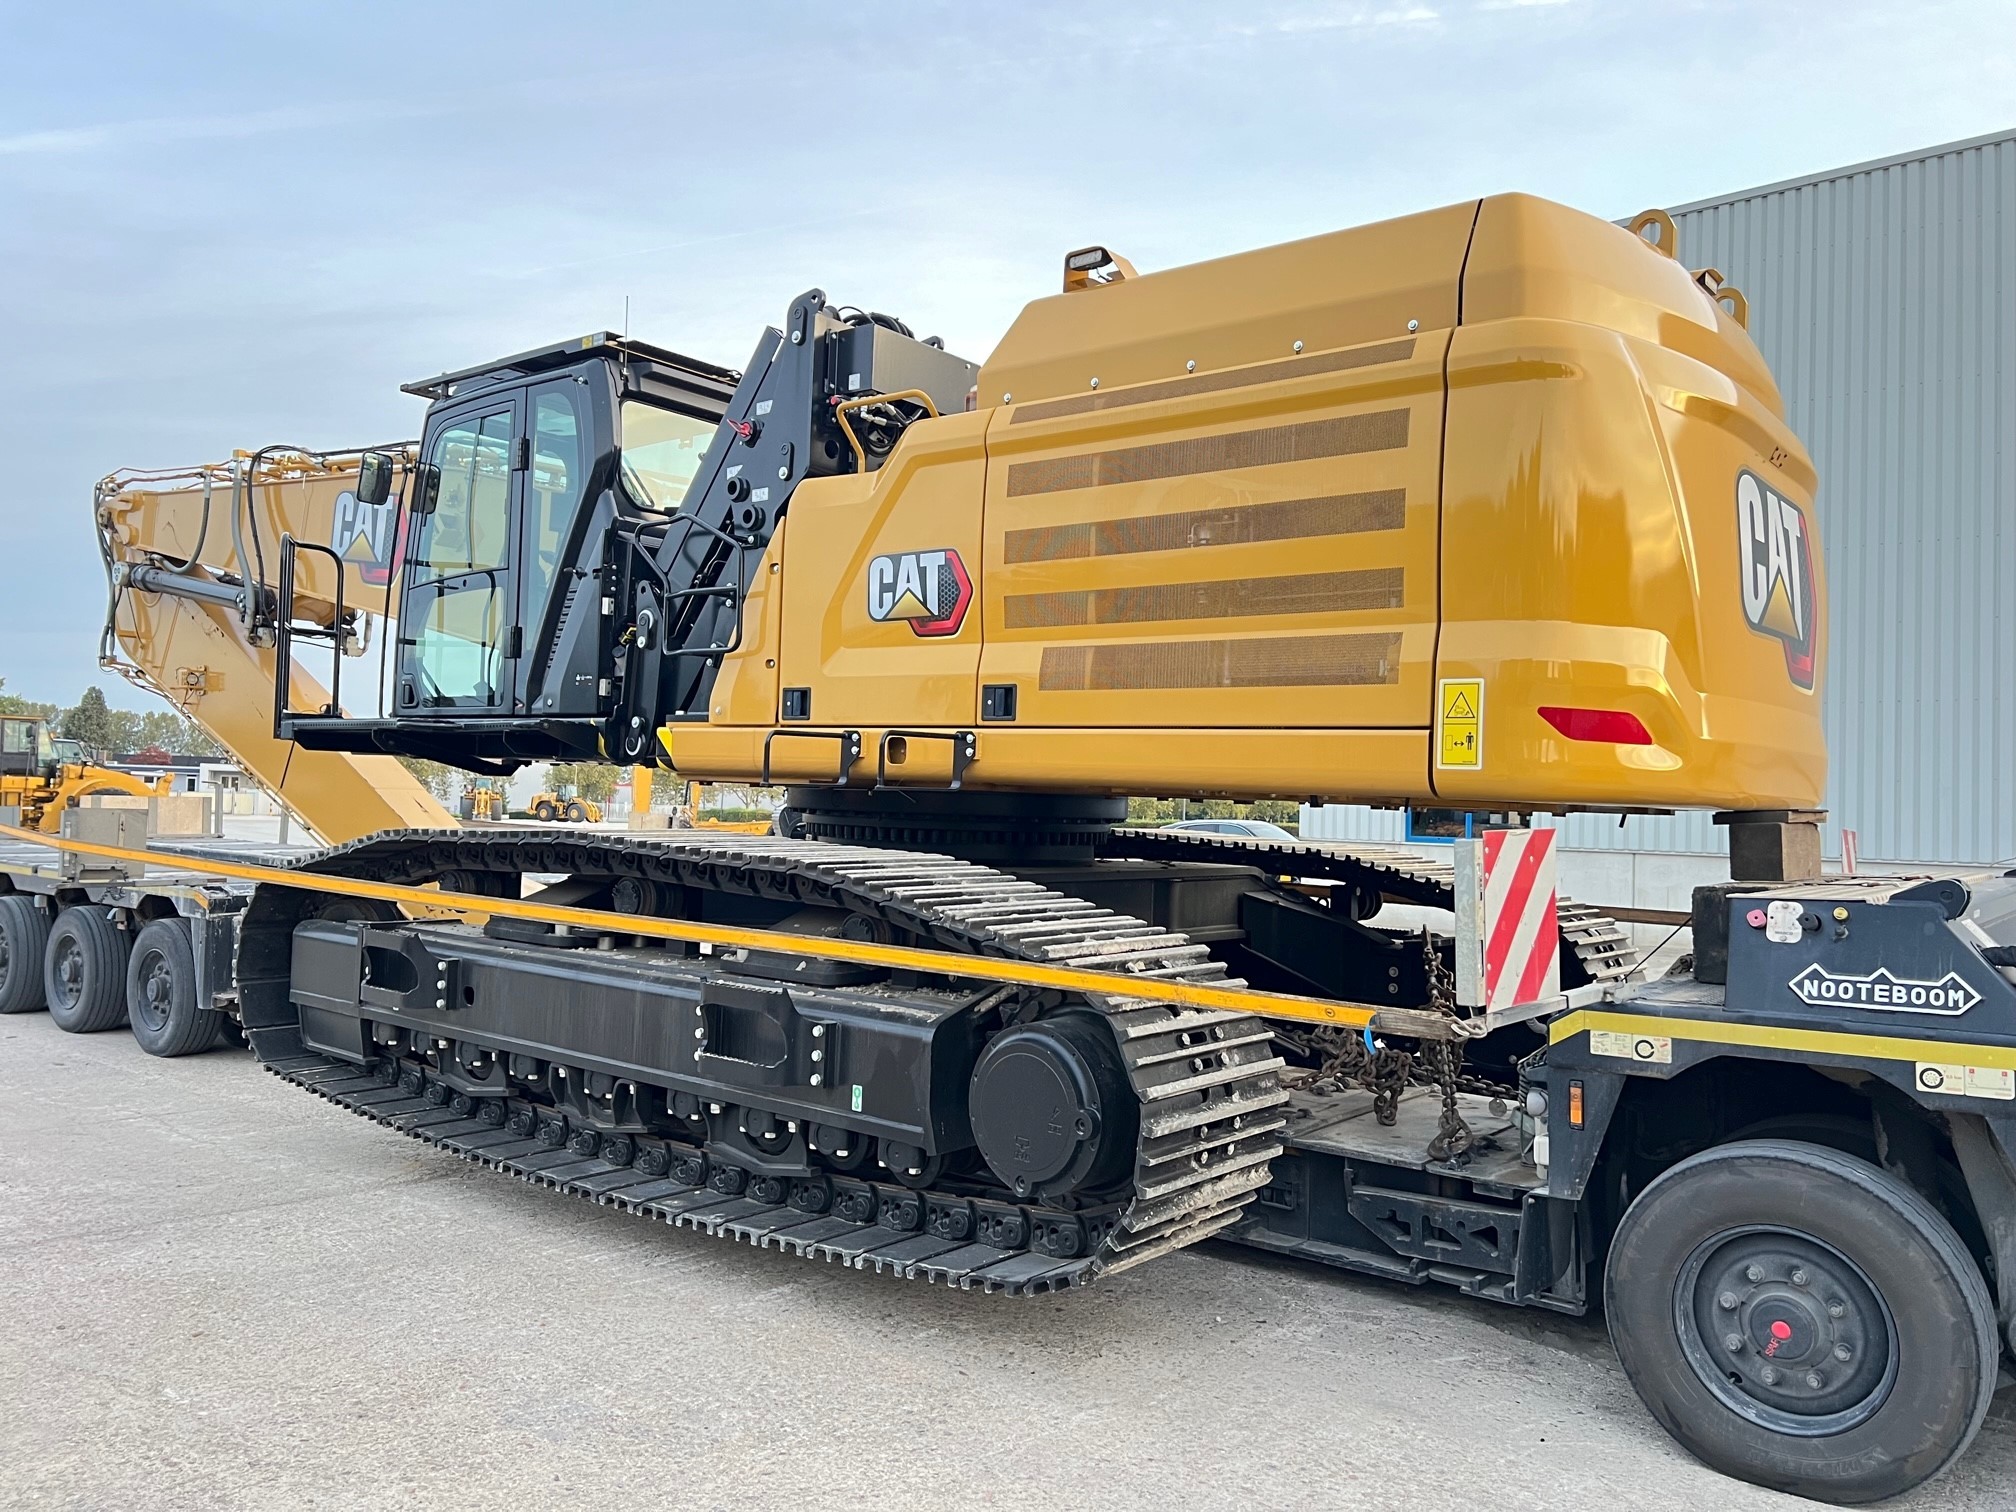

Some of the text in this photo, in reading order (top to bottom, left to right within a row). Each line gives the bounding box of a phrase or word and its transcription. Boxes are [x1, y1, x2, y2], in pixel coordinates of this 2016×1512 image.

[332, 492, 394, 563] CAT
[1738, 475, 1803, 641] CAT
[869, 551, 946, 620] CAT
[1803, 979, 1965, 1008] NOOTEBOOM
